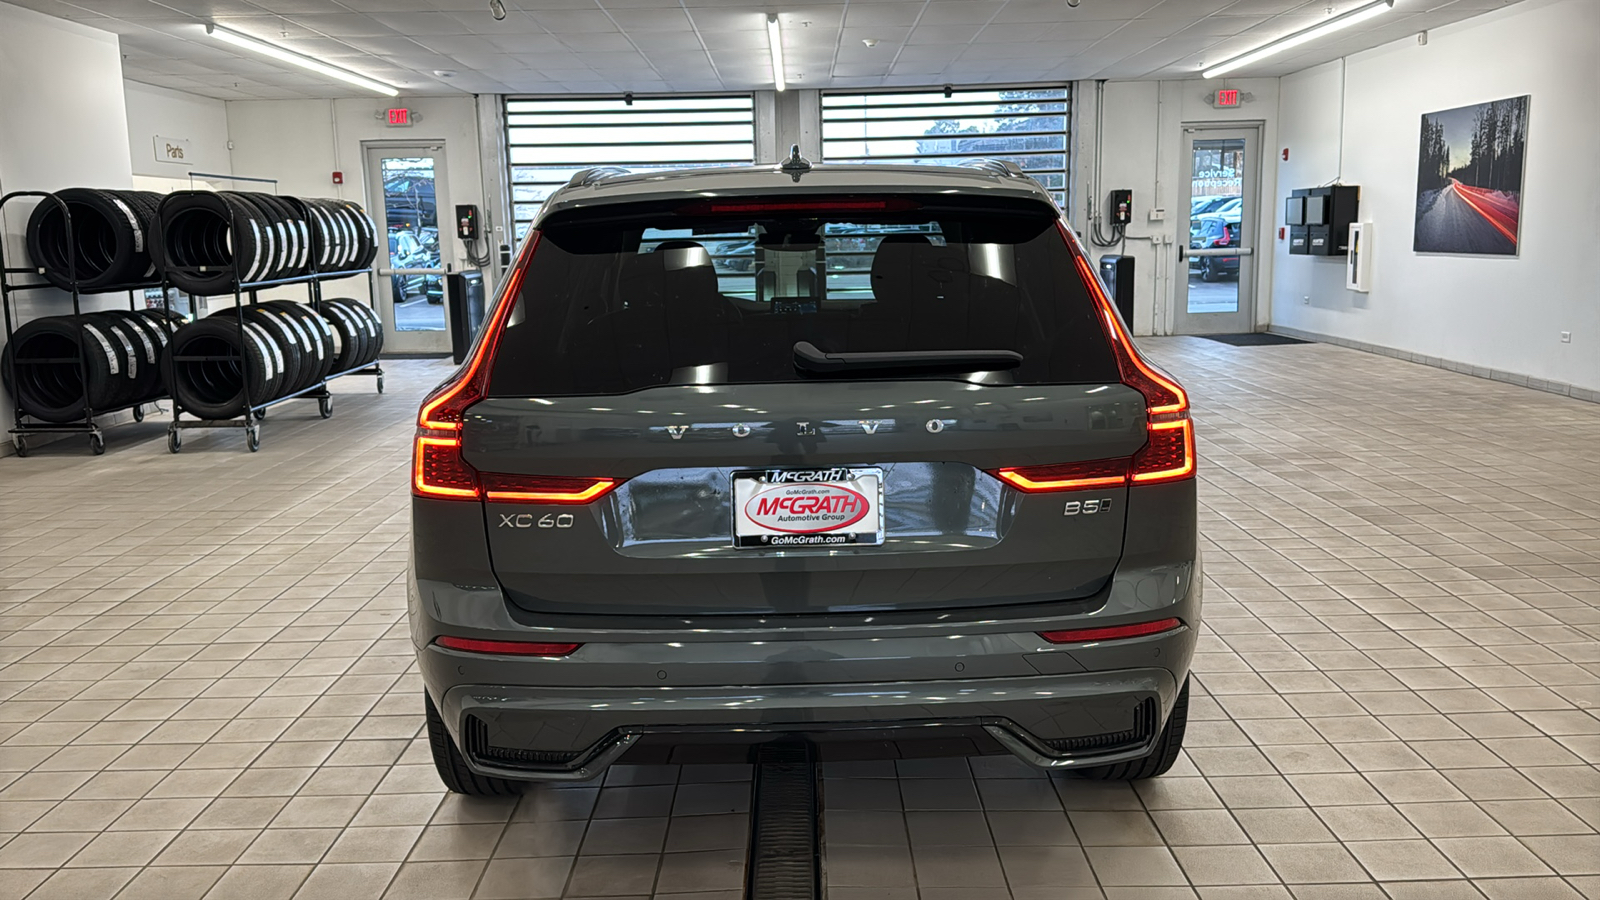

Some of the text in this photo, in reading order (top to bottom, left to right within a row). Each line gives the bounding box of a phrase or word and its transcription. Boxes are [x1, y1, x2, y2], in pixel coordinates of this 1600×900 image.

[1219, 90, 1238, 105] EXIT
[388, 108, 408, 124] EXIT
[166, 143, 184, 159] Parts
[666, 418, 944, 439] VOLVO
[777, 514, 846, 522] Automotive Group
[771, 535, 846, 545] GoMcGrath.com
